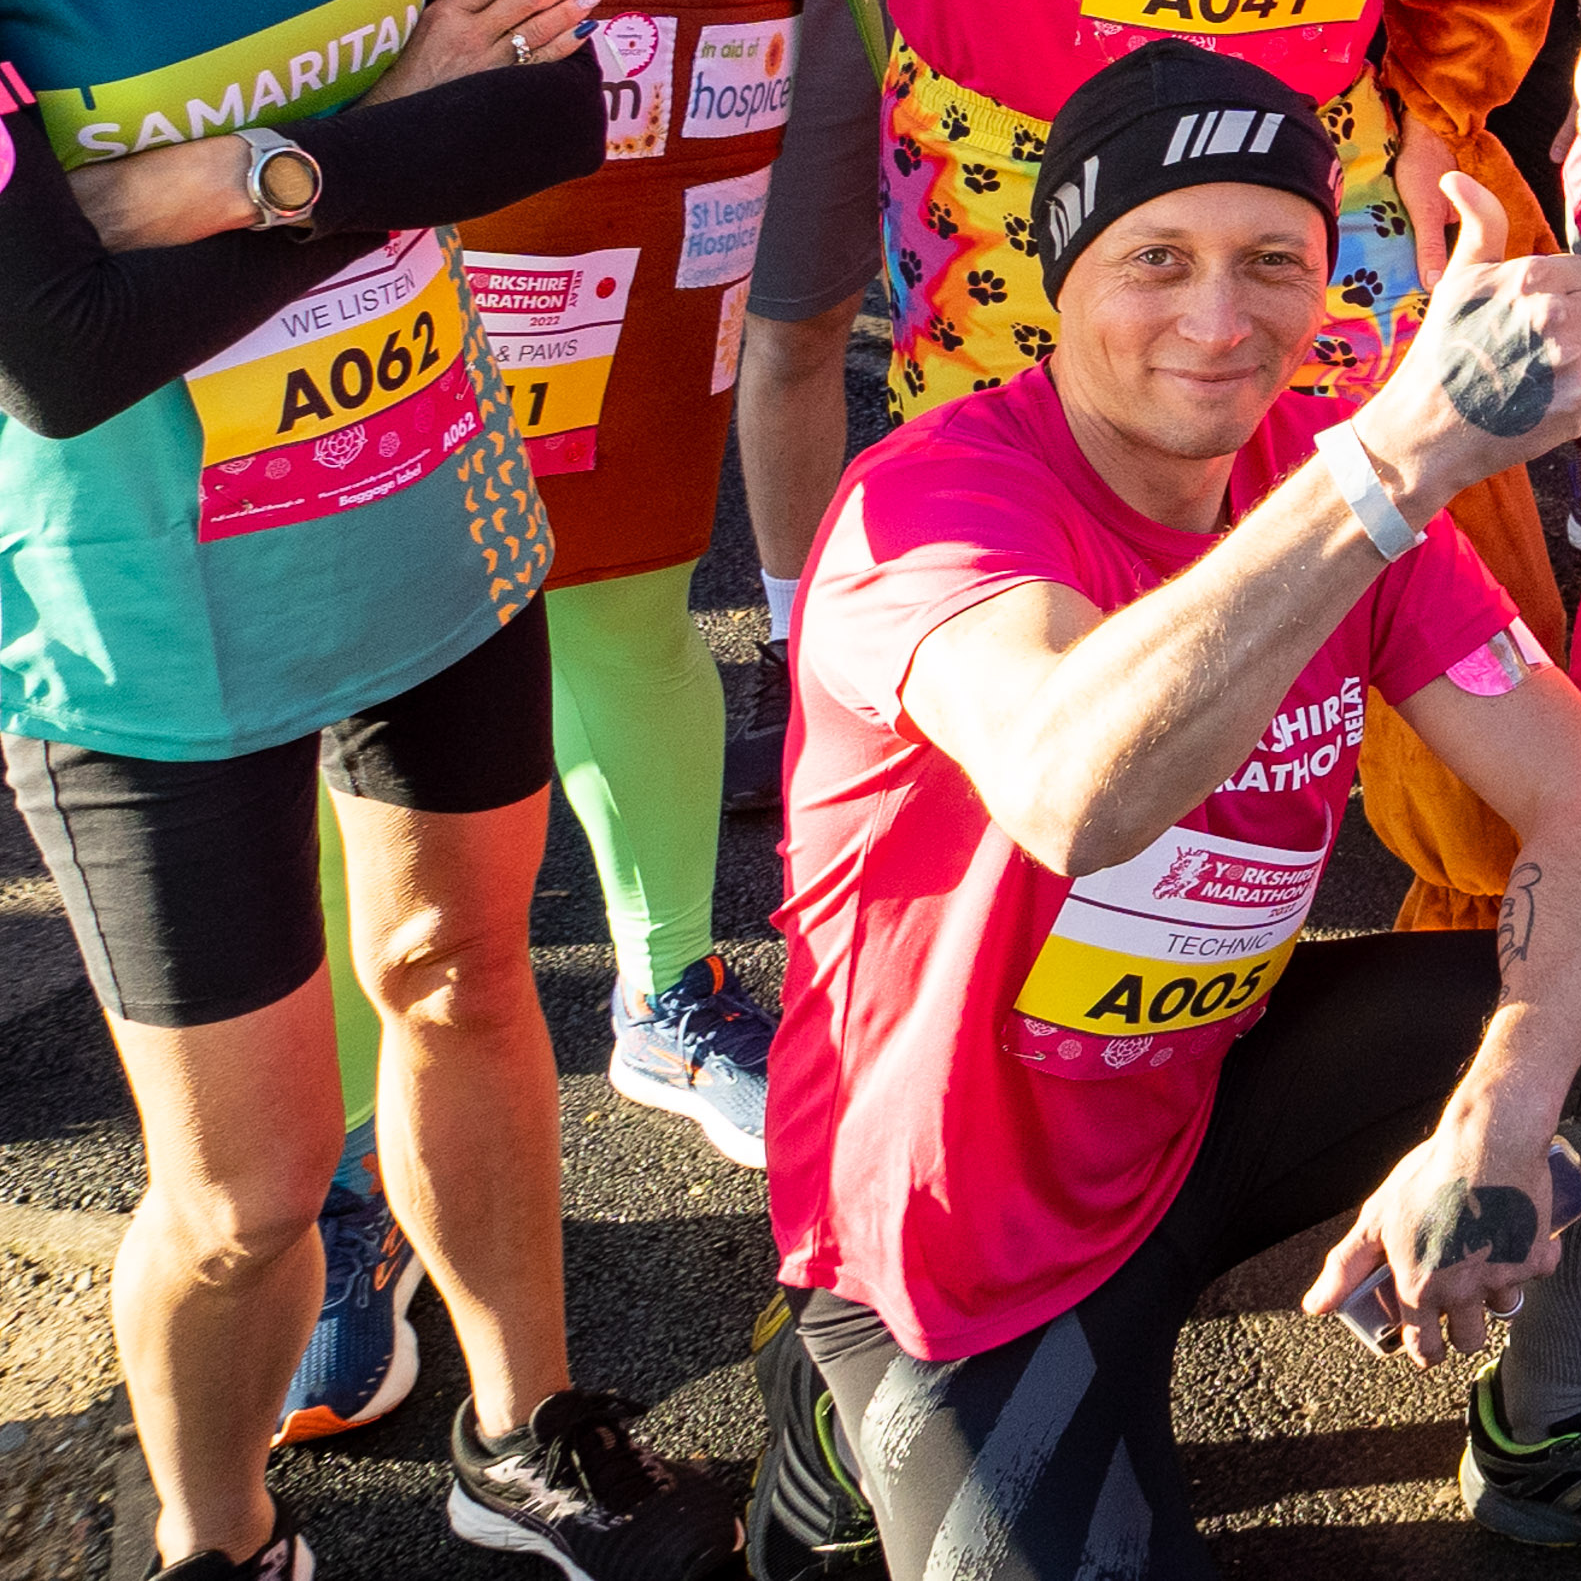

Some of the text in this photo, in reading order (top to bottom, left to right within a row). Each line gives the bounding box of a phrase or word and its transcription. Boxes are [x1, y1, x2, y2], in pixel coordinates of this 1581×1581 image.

[690, 71, 792, 128] hospice
[281, 269, 417, 338] WE LISTEN
[474, 294, 565, 309] ARATHON
[567, 270, 584, 309] RELAY
[530, 315, 561, 327] 2022
[276, 310, 440, 435] A062
[496, 339, 579, 363] & PAWS
[442, 411, 477, 453] A062
[338, 480, 396, 507] Baggage
[396, 463, 423, 485] label
[1342, 676, 1364, 747] RELAY
[1200, 881, 1305, 903] MARATHON
[1084, 961, 1271, 1025] A005
